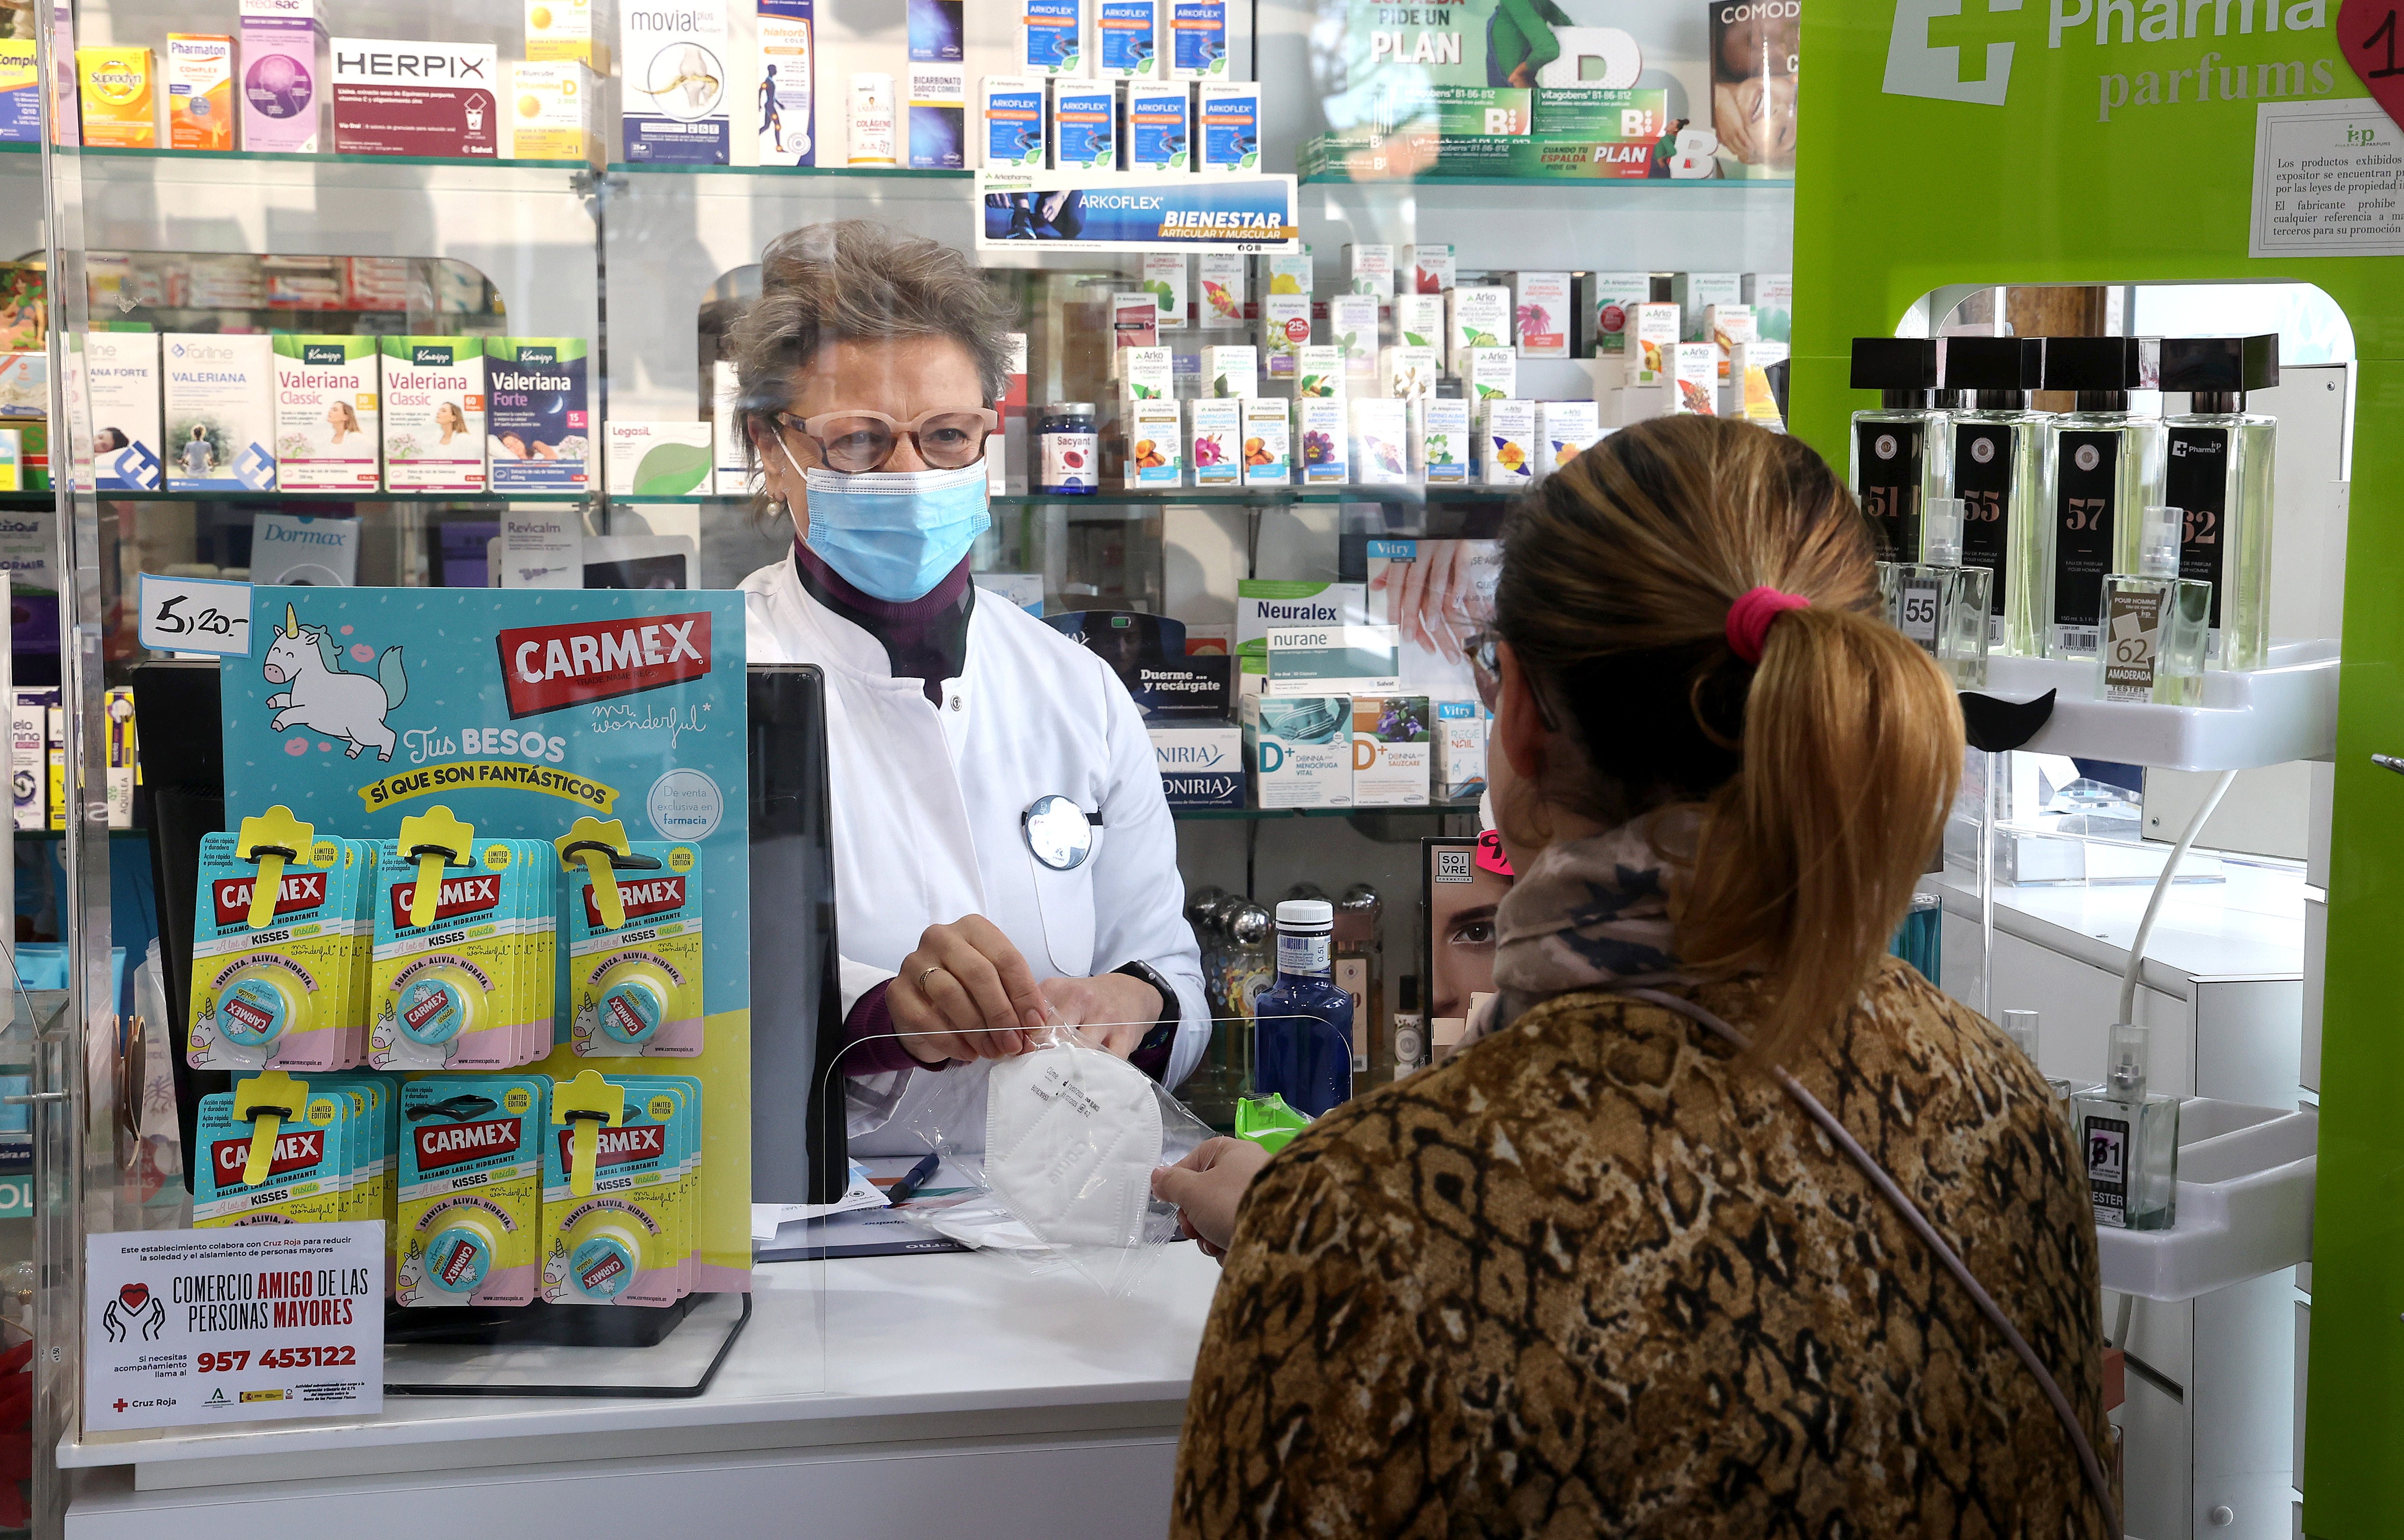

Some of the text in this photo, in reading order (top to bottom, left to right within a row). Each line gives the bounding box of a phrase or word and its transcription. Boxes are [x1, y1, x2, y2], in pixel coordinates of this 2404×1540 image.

[631, 10, 699, 32] movial
[1379, 9, 1450, 26] PIDE UN
[2048, 0, 2325, 49] Pharma
[764, 27, 805, 38] hialsorb
[172, 42, 226, 55] Pharmaton
[1371, 32, 1461, 64] PLAN
[338, 53, 484, 79] HERPIX
[563, 80, 577, 95] D
[914, 76, 961, 86] BICARBONATO
[2096, 53, 2334, 122] parfums
[1593, 147, 1646, 163] PLAN
[2278, 154, 2402, 170] Los productos exhibidos
[2277, 171, 2320, 183] expositor
[2338, 170, 2391, 178] encuentran
[2276, 180, 2396, 196] por las leyes de propiedad
[1079, 196, 1160, 210] ARKOFLEX
[2275, 199, 2395, 212] El fabricante prohíbe
[1165, 212, 1281, 228] BIENESTAR
[2274, 212, 2371, 226] cualquier referencia
[1162, 228, 1281, 239] ARTICULAR Y MUSCULAR
[2273, 226, 2310, 235] terceros
[2313, 227, 2334, 238] para
[2350, 224, 2400, 237] promoción
[307, 349, 341, 362] Kneipp
[113, 368, 147, 377] FORTE
[172, 372, 246, 383] VALERIANA
[279, 371, 359, 389] Valeriana
[389, 372, 467, 390] Valeriana
[492, 372, 571, 391] Valeriana
[281, 392, 322, 405] Classic
[390, 393, 431, 405] Classic
[494, 392, 528, 406] Forte
[1057, 436, 1090, 448] Sacyant
[1867, 486, 1899, 518] 51
[1964, 490, 2001, 522] 55
[2066, 498, 2105, 531] 57
[508, 521, 560, 534] Revicalm
[2180, 511, 2216, 544] 62
[265, 524, 346, 547] Dormax
[1377, 543, 1409, 557] Vitry
[1258, 601, 1337, 621] Neuralex
[1905, 598, 1934, 623] 55
[1275, 633, 1327, 645] nurane
[515, 620, 703, 685] CARMEX
[2116, 638, 2147, 664] 62
[576, 675, 604, 686] TRADE
[1141, 670, 1193, 680] Duerme
[2108, 669, 2151, 681] AMADERADA
[1144, 681, 1220, 693] y recárgate
[1444, 706, 1470, 717] Vitry
[404, 726, 566, 763] Tus BESOS
[1451, 740, 1474, 748] NAIL
[371, 764, 606, 805] SÍ QUE SON FANTÁSTICOS
[664, 787, 706, 797] De venta
[1163, 779, 1224, 794] ONIRIA
[120, 777, 128, 815] AQUILEA
[657, 802, 698, 811] exclusiva
[664, 814, 707, 825] farmacia
[1442, 865, 1467, 874] VRE
[395, 912, 493, 939] BÁLSAMO LABIAL HIDRATANTE
[252, 931, 289, 945] KISSES
[428, 931, 465, 947] KISSES
[216, 955, 311, 989] SUAVIZA. ALIVIA. HIDRATA.
[395, 956, 487, 989] SUAVIZA. ALIVIA. HIDRATA.
[423, 1122, 516, 1154] CARMEX
[2093, 1192, 2123, 1207] ESTER
[141, 1244, 207, 1253] establecimiento
[284, 1239, 301, 1248] Roja
[199, 1250, 246, 1259] aislamiento
[261, 1248, 297, 1257] personas
[299, 1247, 333, 1255] mayores
[173, 1268, 368, 1303] COMERCIO AMIGO DE LAS
[189, 1298, 352, 1332] PERSONAS MAYORES
[149, 1354, 187, 1362] necesitas
[197, 1346, 356, 1372] 957 453122
[114, 1361, 186, 1372] acompañamiento
[156, 1397, 176, 1407] Roja
